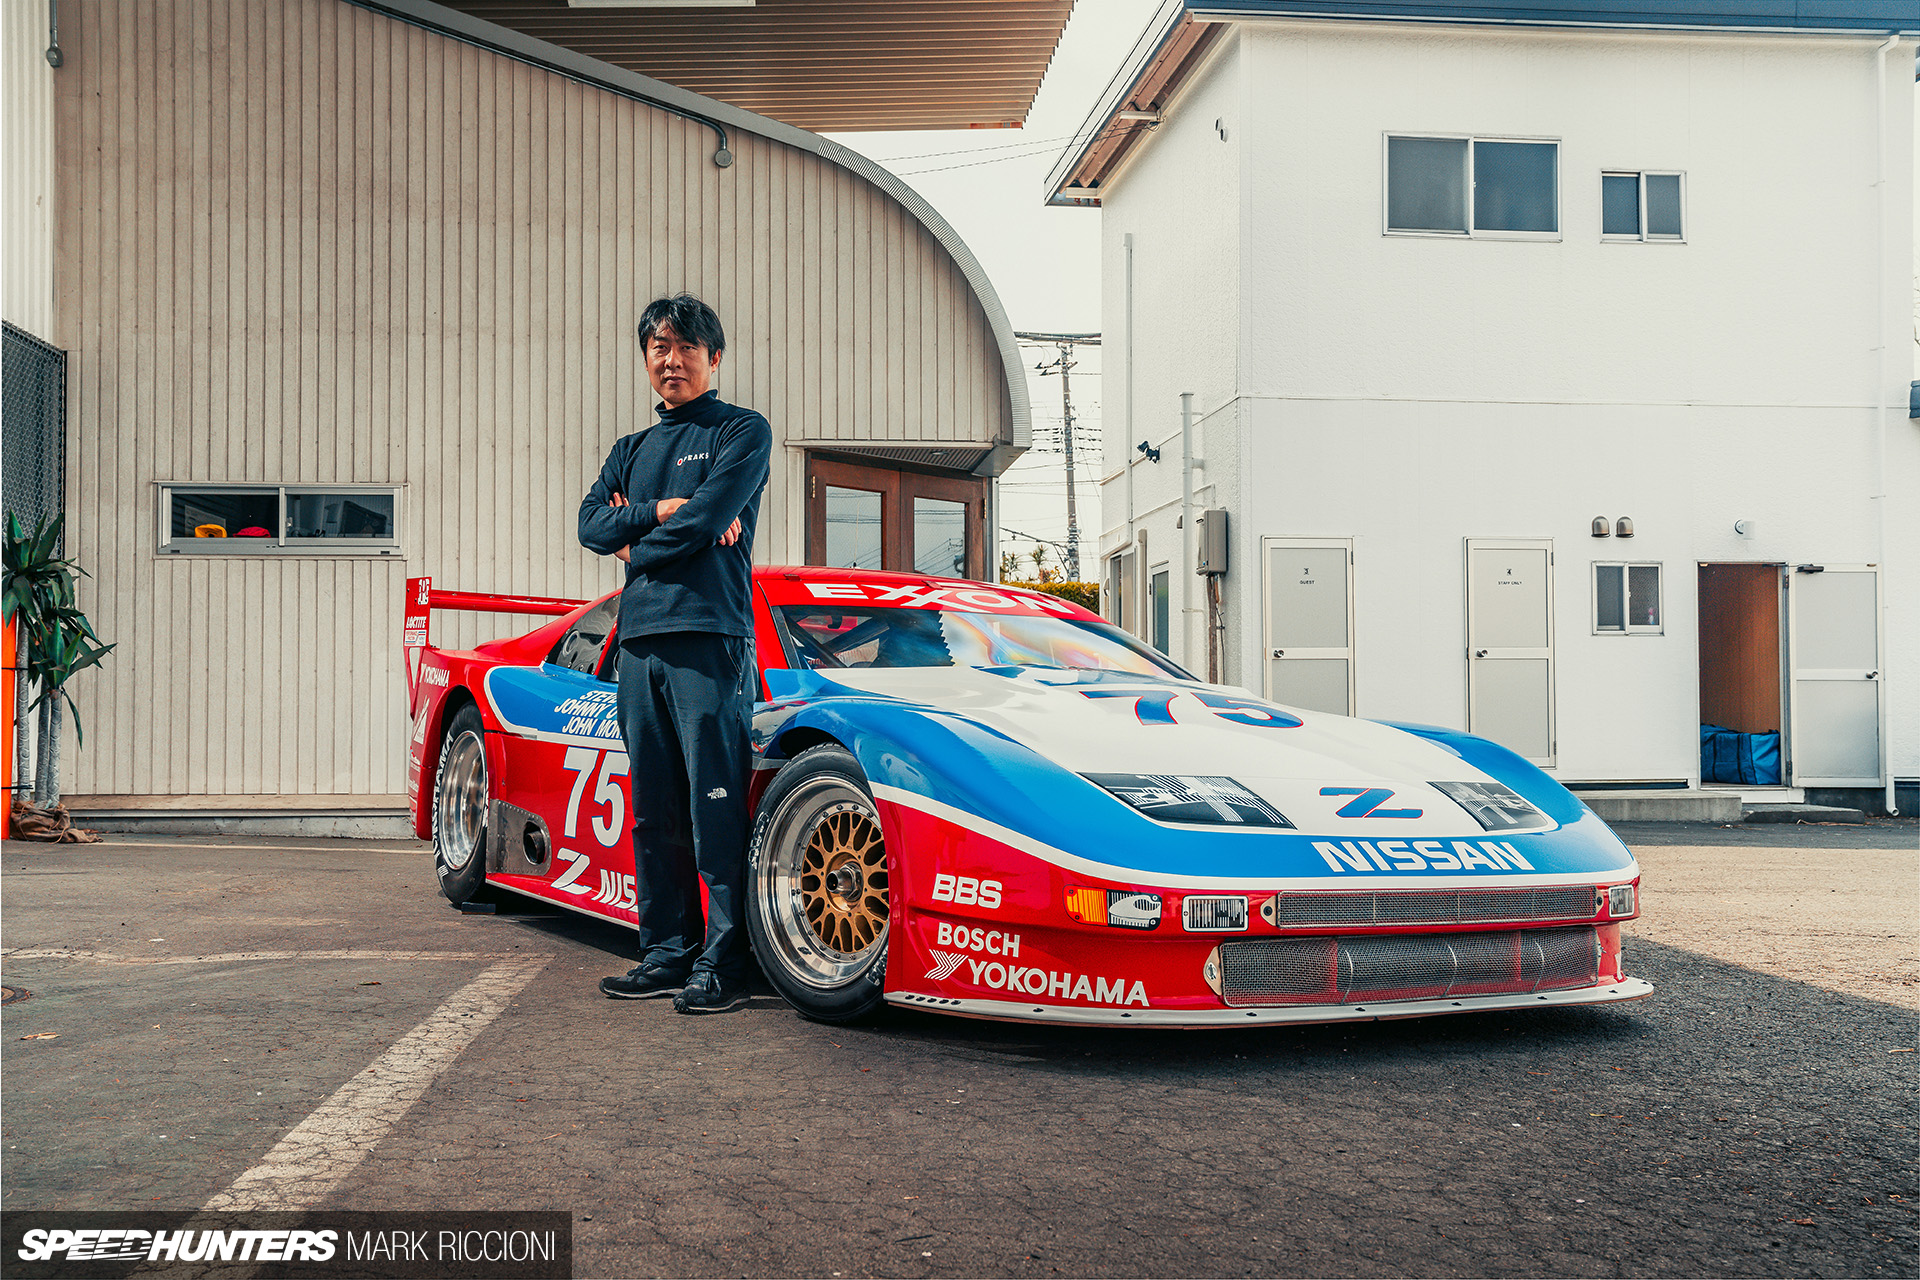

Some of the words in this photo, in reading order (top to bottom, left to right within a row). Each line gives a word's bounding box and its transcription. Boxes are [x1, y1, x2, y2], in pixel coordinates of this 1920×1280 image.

[804, 583, 1076, 614] EXXON
[406, 616, 427, 629] LOCTITE
[554, 698, 612, 718] JOHNNY
[562, 716, 598, 736] JOHN
[1078, 690, 1304, 729] 75
[563, 745, 631, 848] 75
[1311, 841, 1535, 872] NISSAN
[591, 868, 638, 913] NIS
[932, 873, 1003, 909] BBS
[937, 922, 1020, 958] BOSCH
[968, 958, 1149, 1007] YOKOHAMA
